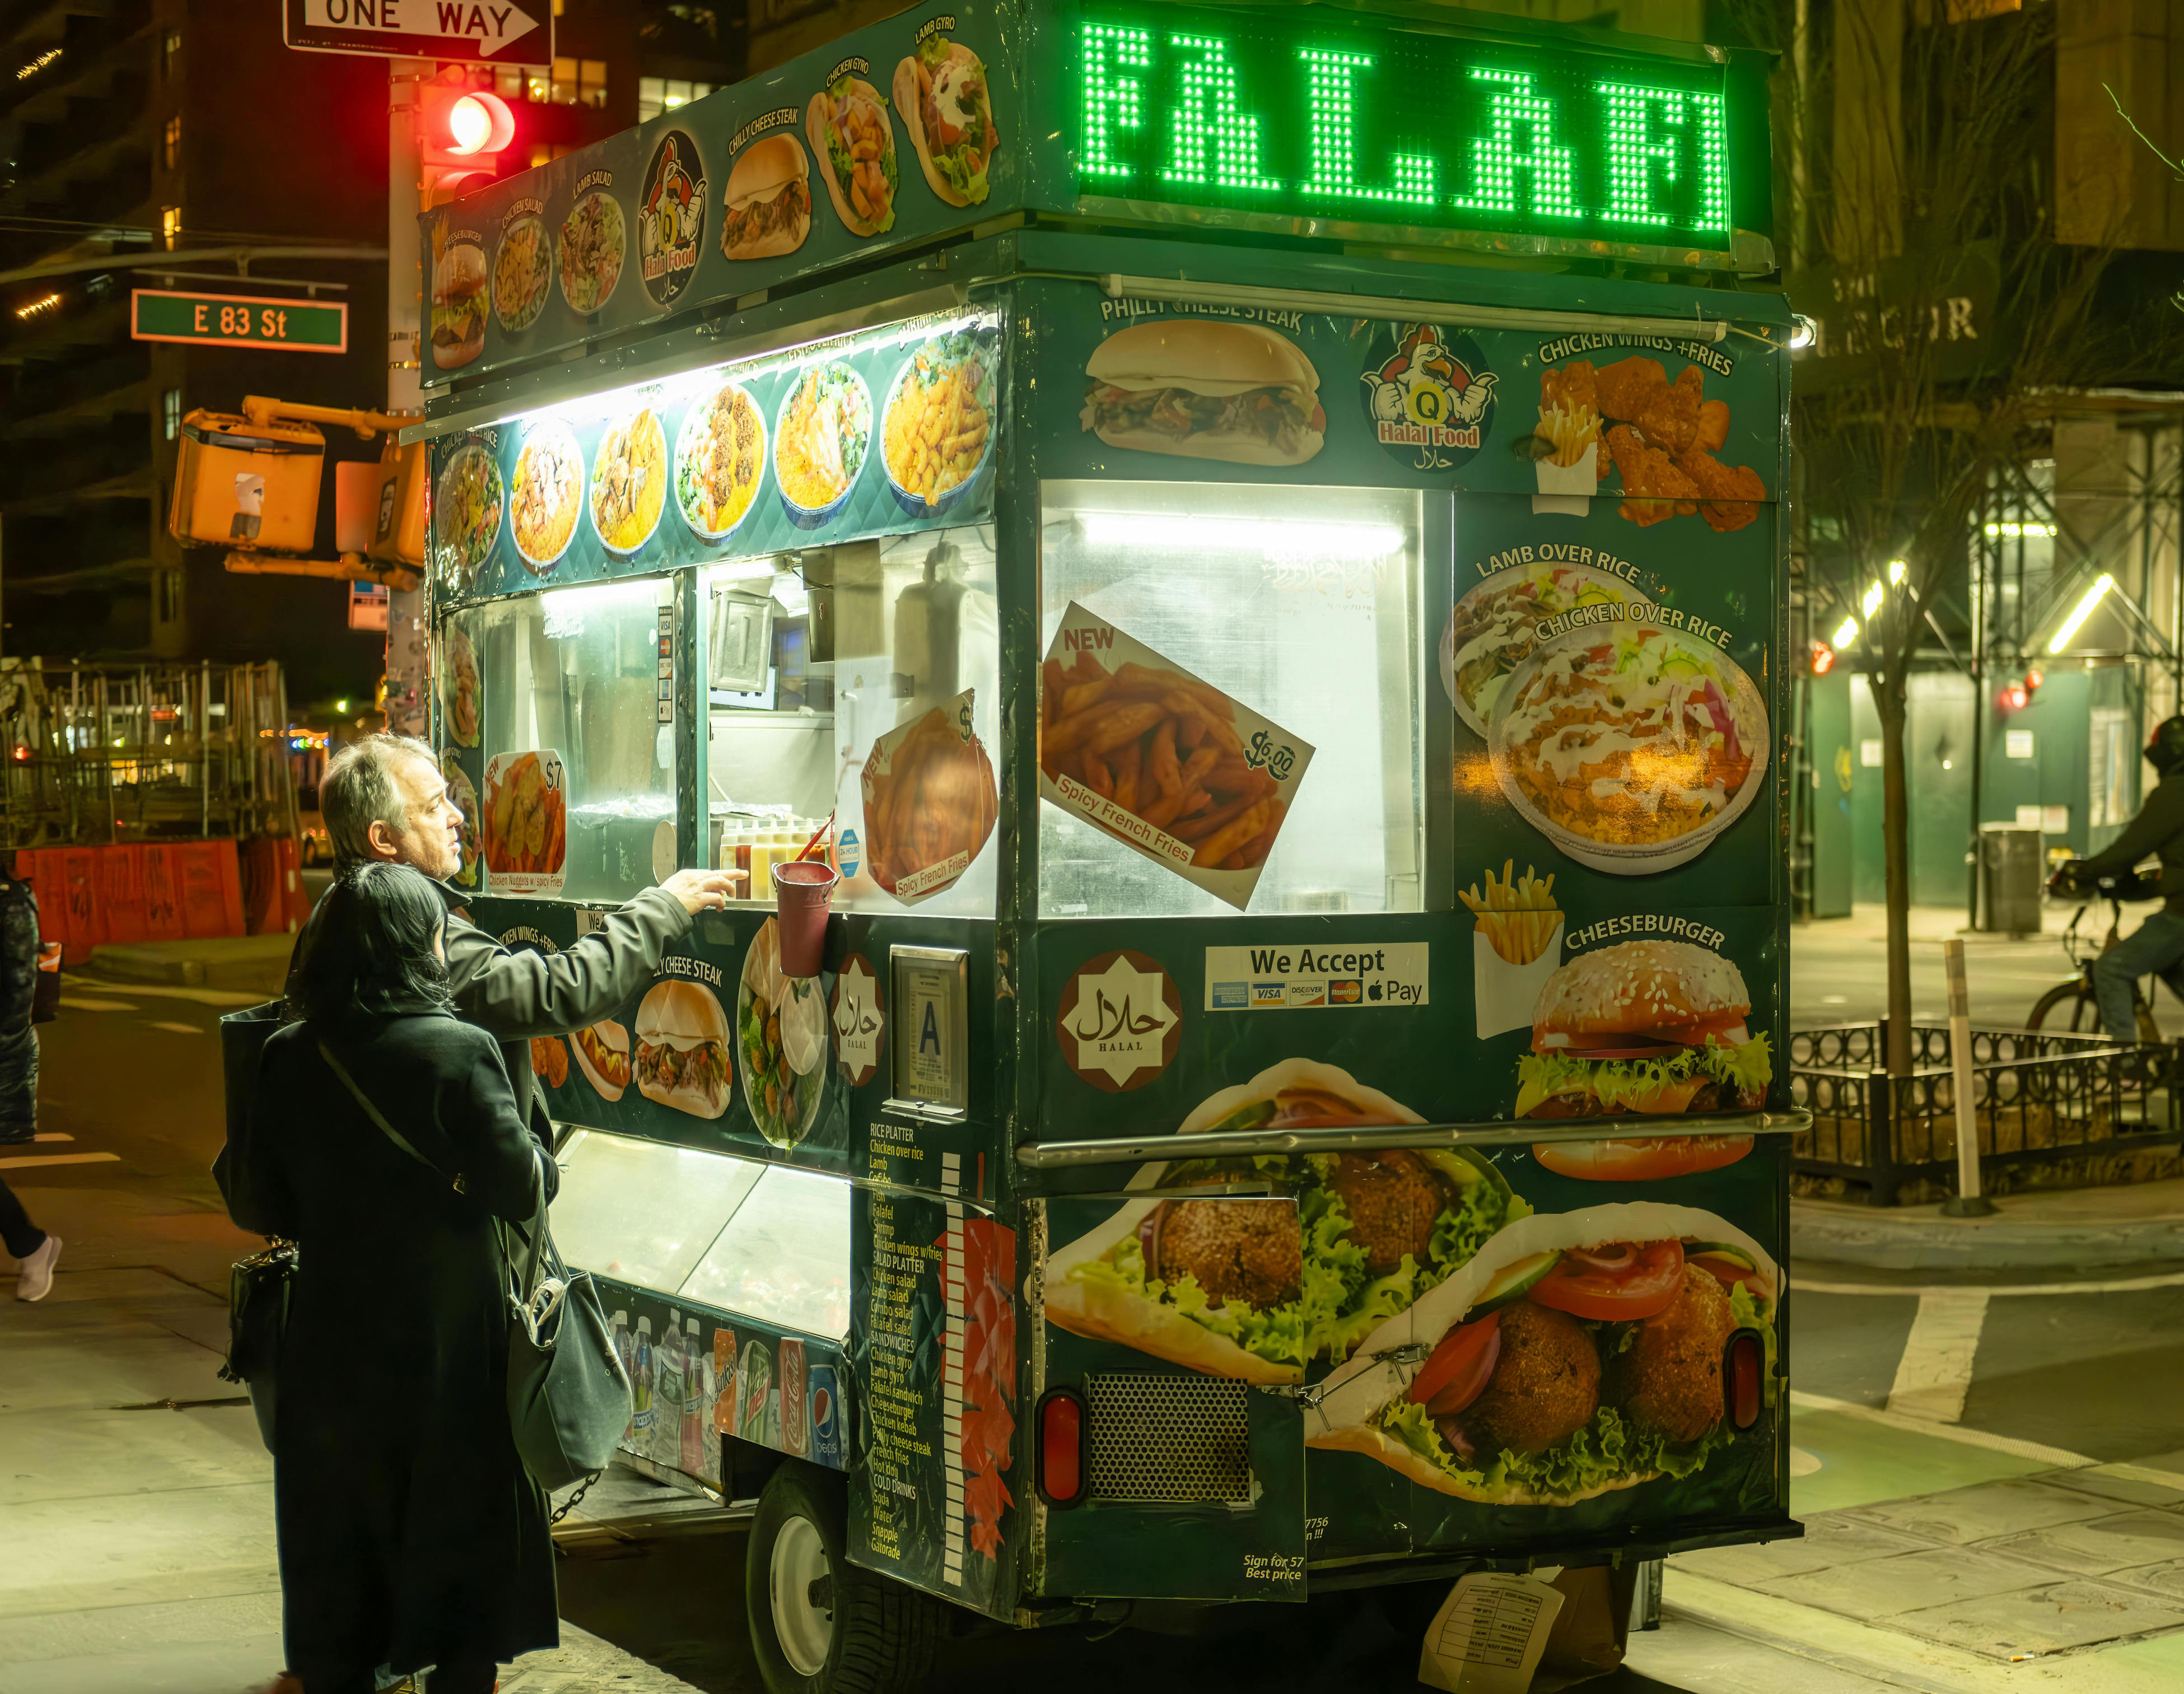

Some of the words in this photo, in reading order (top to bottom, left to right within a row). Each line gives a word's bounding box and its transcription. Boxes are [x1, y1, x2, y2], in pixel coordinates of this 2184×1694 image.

[326, 0, 400, 28] ONE
[437, 2, 512, 37] WAY
[914, 24, 935, 45] LAMB
[936, 15, 955, 32] GYRO
[826, 59, 853, 88] CHICKEN
[853, 57, 869, 74] GYRO
[729, 118, 749, 156] CHILLY
[750, 111, 776, 138] CHEESE
[777, 107, 798, 127] STEAK
[1080, 21, 1726, 232] FALAF
[573, 175, 592, 200] LAMB
[592, 170, 612, 189] SALAD
[525, 198, 543, 215] SALAD
[444, 230, 482, 251] HEESEBURGER
[646, 256, 666, 278] Hala
[669, 244, 695, 270] Food
[194, 305, 209, 333] E
[219, 306, 251, 337] 83
[261, 308, 288, 339] St
[1540, 334, 1613, 363] CHICKEN
[1677, 341, 1733, 376] +FRIES
[1415, 390, 1440, 421] Q
[483, 427, 498, 449] RICE
[1379, 421, 1427, 444] Halal
[1434, 423, 1478, 447] Food
[1476, 545, 1534, 578] LAMB
[1539, 543, 1593, 565] OVER
[1597, 552, 1641, 584] RICE
[660, 621, 671, 631] VISA
[1535, 602, 1625, 641] CHICKEN
[1628, 602, 1684, 628] OVER
[1687, 615, 1733, 650] RICE
[1064, 628, 1114, 651] NEW
[485, 755, 500, 784] NEW
[861, 739, 884, 788] NEW
[1058, 779, 1100, 813] Spicy
[1102, 803, 1151, 841] French
[1154, 833, 1189, 862] Fries
[489, 875, 507, 886] Chicken
[508, 875, 529, 888] Nuggets
[550, 875, 563, 887] Fries
[898, 878, 918, 897] Spicy
[920, 862, 946, 886] French
[948, 856, 968, 874] Fries
[588, 912, 600, 931] We
[1566, 914, 1725, 950] CHEESEBURGER
[498, 928, 517, 946] ICKEN
[517, 925, 538, 944] WINGS
[665, 955, 692, 976] CHEESE
[693, 959, 722, 987] STEAK
[1250, 950, 1290, 974] We
[1298, 949, 1385, 978] Accept
[1257, 988, 1281, 999] VISA
[1387, 980, 1422, 1005] Pay
[1076, 987, 1165, 1042] حلال
[919, 1000, 941, 1056] A
[1099, 1042, 1143, 1052] HALAL
[870, 1122, 885, 1138] RICE
[886, 1125, 914, 1143] PLATTER
[869, 1155, 888, 1170] Lamb
[870, 1139, 895, 1156] Chicken
[896, 1146, 911, 1159] over
[911, 1146, 923, 1161] rice
[872, 1203, 894, 1220] Falafel
[872, 1219, 895, 1240] Shrimp
[873, 1234, 896, 1252] Chicken
[897, 1241, 919, 1259] wings
[920, 1244, 943, 1262] w/fries
[873, 1250, 892, 1268] SALAD
[893, 1256, 925, 1274] PLATTER
[872, 1266, 895, 1285] Chicken
[896, 1273, 916, 1289] salad
[871, 1282, 888, 1299] Lamb
[888, 1288, 909, 1303] salad
[871, 1298, 893, 1315] Combo
[894, 1305, 914, 1320] salad
[870, 1314, 893, 1332] Falafel
[894, 1320, 912, 1337] salad
[870, 1330, 914, 1354] SANDWICHES
[870, 1346, 896, 1365] Chicken
[897, 1356, 912, 1371] gyro
[870, 1361, 888, 1379] Lamb
[889, 1370, 904, 1385] gyro
[870, 1377, 892, 1397] Falafel
[892, 1386, 923, 1406] sandwich
[870, 1394, 914, 1421] Cheeseburger
[872, 1411, 896, 1432] Chicken
[897, 1420, 917, 1436] kebab
[872, 1424, 889, 1446] Philly
[890, 1434, 912, 1450] cheese
[913, 1441, 931, 1457] steak
[872, 1441, 894, 1461] French
[895, 1448, 909, 1466] fries
[873, 1457, 885, 1473] Hot
[885, 1462, 898, 1481] dog
[873, 1489, 889, 1508] Soda
[874, 1473, 891, 1491] COLD
[892, 1480, 916, 1500] DRINKS
[873, 1505, 892, 1523] Water
[871, 1520, 898, 1543] Snapple
[871, 1537, 900, 1560] Gatorade
[1243, 1555, 1268, 1569] Sign
[1271, 1555, 1288, 1567] for
[1290, 1557, 1304, 1568] 57
[1245, 1567, 1270, 1579] Best
[1272, 1568, 1301, 1581] price
